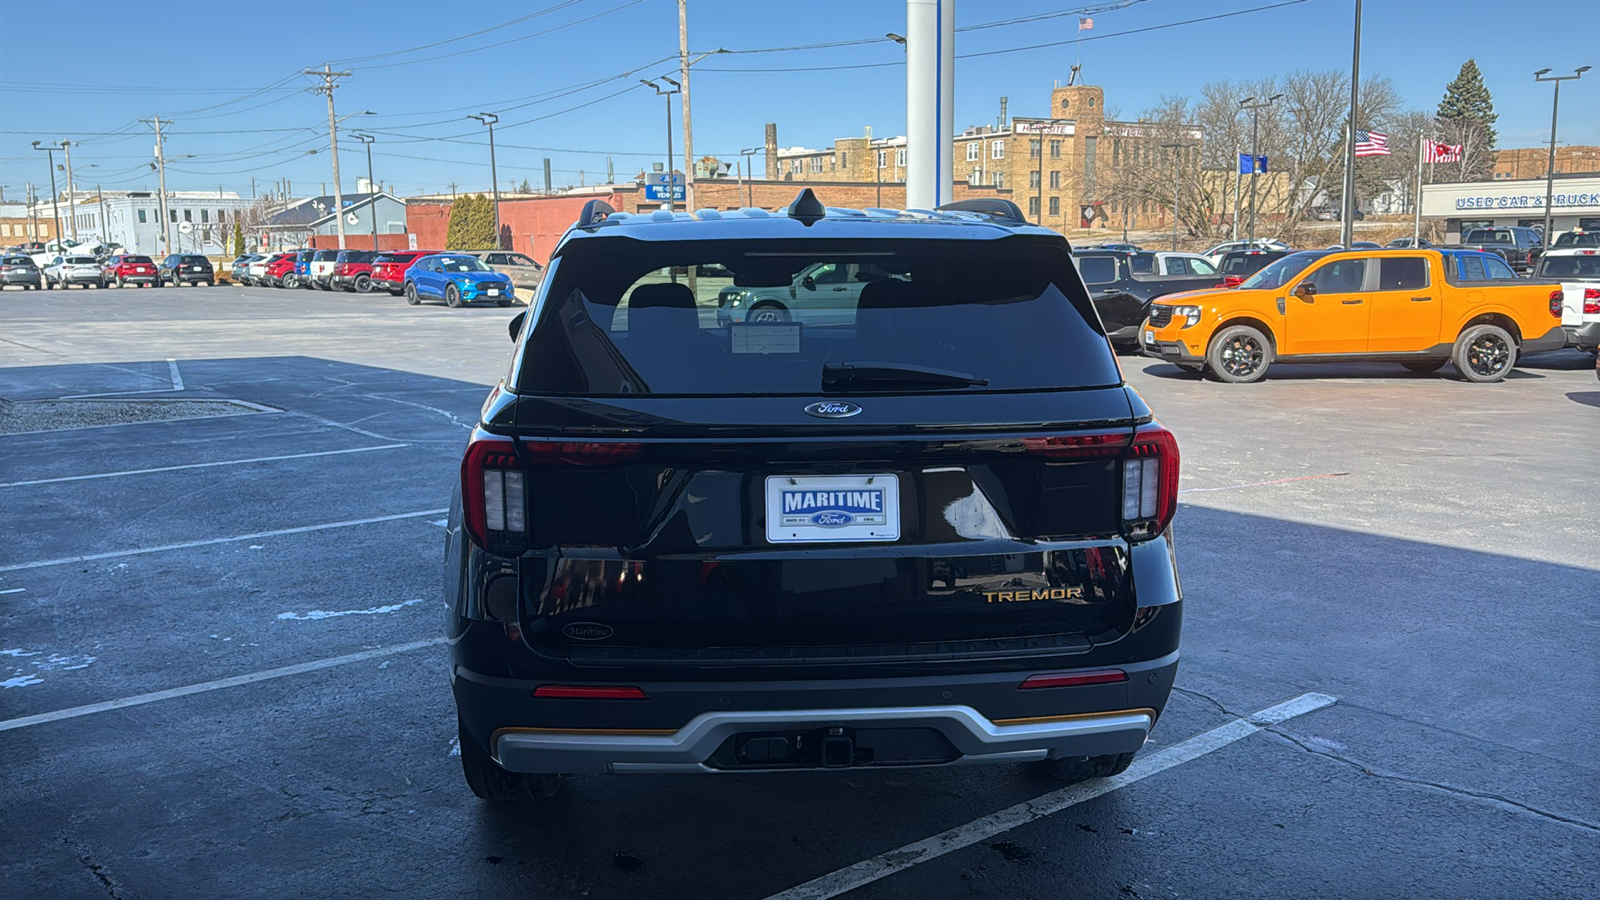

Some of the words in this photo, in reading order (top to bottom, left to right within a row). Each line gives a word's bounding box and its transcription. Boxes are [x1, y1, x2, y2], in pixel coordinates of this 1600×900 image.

[1457, 197, 1494, 207] USED
[1499, 196, 1529, 206] CAR
[1534, 195, 1543, 205] &
[818, 402, 849, 413] Ford
[785, 492, 880, 512] MARITIME
[818, 514, 846, 525] Ford
[982, 588, 1081, 602] TREMOR
[569, 626, 609, 636] Maritime
